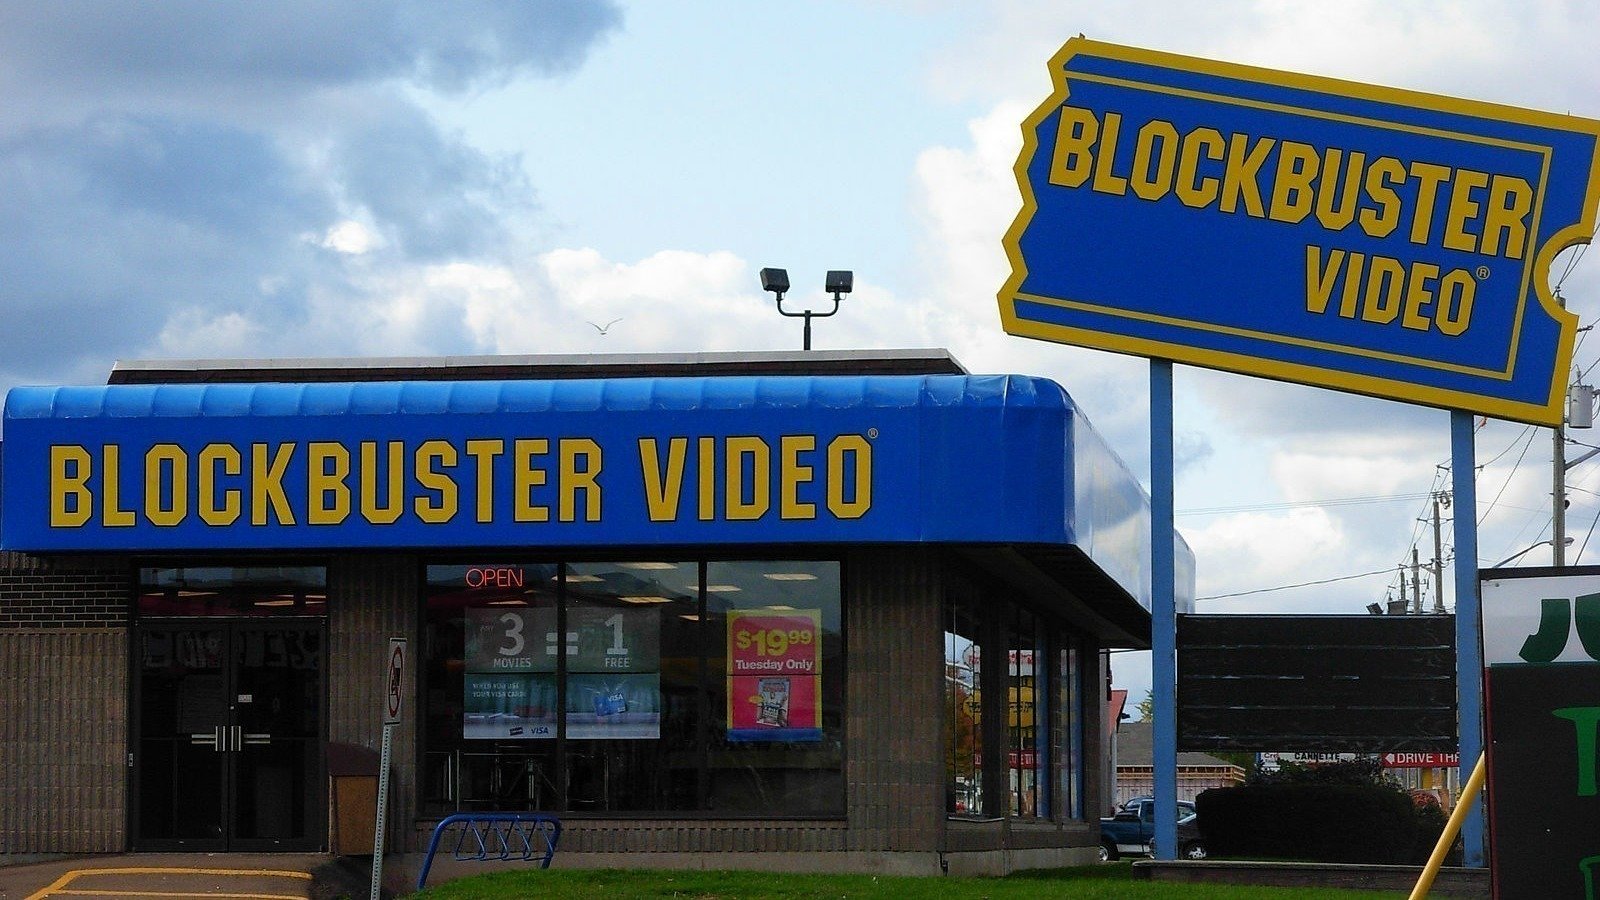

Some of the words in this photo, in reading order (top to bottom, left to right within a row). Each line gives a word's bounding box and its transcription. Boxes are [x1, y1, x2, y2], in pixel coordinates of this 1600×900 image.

[1047, 104, 1535, 260] BLOCKBUSTER
[49, 437, 603, 529] BLOCKBUSTER
[465, 568, 524, 588] OPEN
[498, 612, 525, 656] 3
[604, 613, 629, 655] 1
[493, 657, 532, 669] MOVIES
[604, 657, 631, 668] FREE
[735, 659, 784, 671] Tuesday
[785, 659, 813, 671] Only
[530, 726, 549, 735] VISA
[1397, 752, 1434, 764] DRIVE
